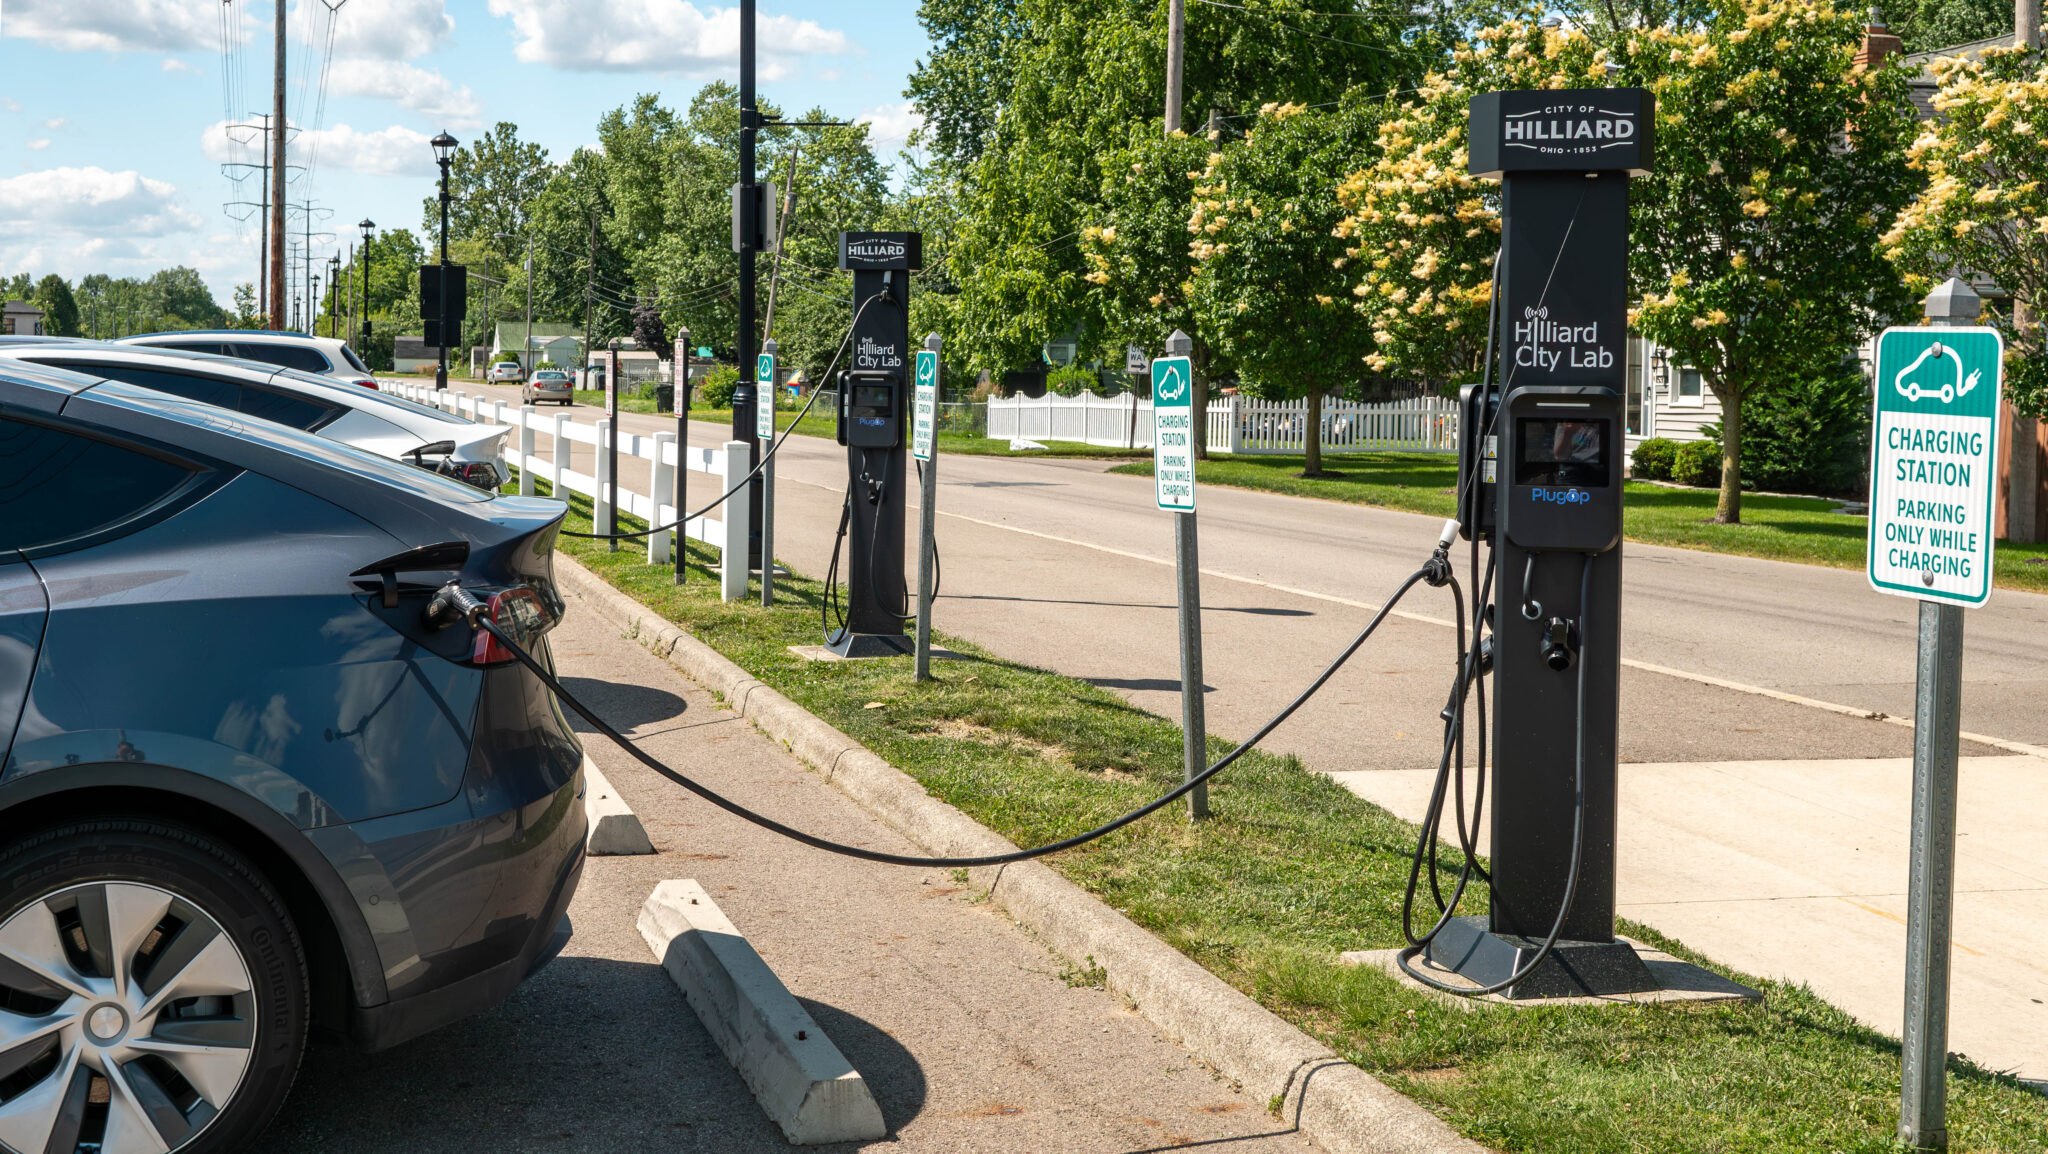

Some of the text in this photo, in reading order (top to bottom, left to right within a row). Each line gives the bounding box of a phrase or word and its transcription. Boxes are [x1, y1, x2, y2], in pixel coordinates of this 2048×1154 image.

[1545, 105, 1595, 114] CITY OF
[1505, 119, 1634, 140] HILLIARD
[1540, 146, 1564, 154] OHIO
[848, 245, 905, 255] HILLIARD
[1515, 317, 1597, 343] Hilliard
[882, 355, 902, 367] Lab
[1515, 346, 1613, 372] City Lab
[1158, 415, 1189, 429] CHARGING
[1162, 432, 1186, 446] STATION
[1888, 426, 1983, 457] CHARGING
[1163, 455, 1186, 467] PARKING
[1160, 469, 1190, 482] ONLY WHILE
[1896, 458, 1971, 488] STATION
[1162, 484, 1190, 497] CHARGING
[1897, 498, 1966, 525] PARKING
[1885, 522, 1977, 553] ONLY WHILE
[1888, 548, 1971, 578] CHARGING
